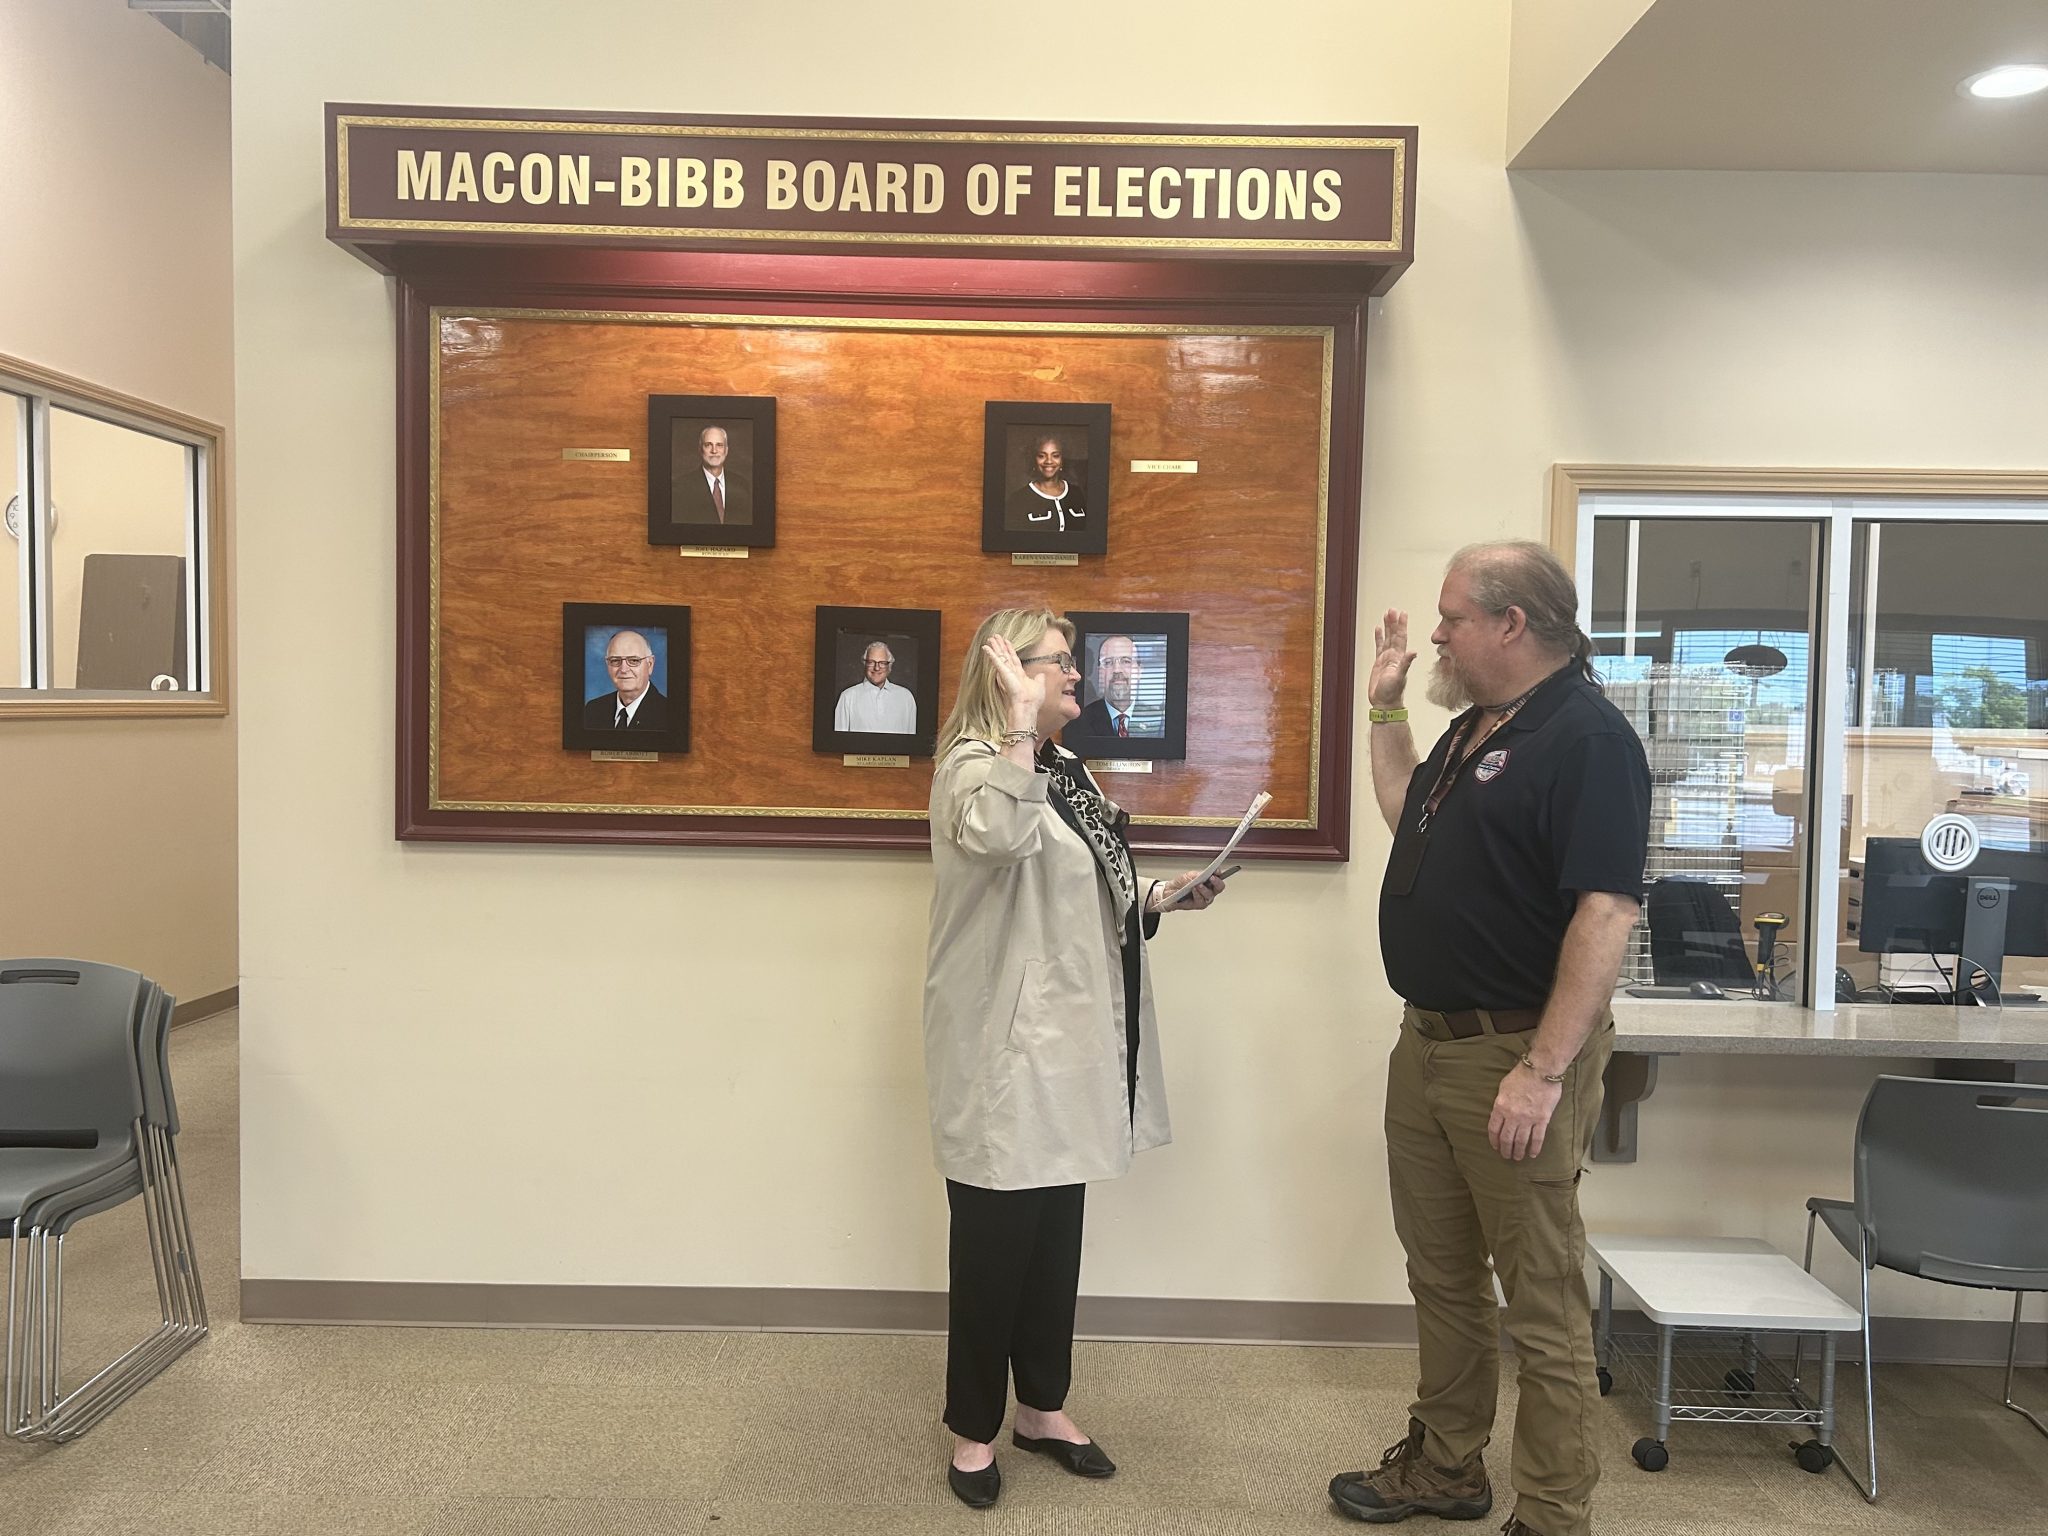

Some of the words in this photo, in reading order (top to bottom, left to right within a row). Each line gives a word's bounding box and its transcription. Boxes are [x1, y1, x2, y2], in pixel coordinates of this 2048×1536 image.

[397, 149, 745, 209] MACON-BIBB
[766, 159, 945, 214] BOARD
[966, 163, 1033, 216] OF
[1053, 165, 1342, 222] ELECTIONS
